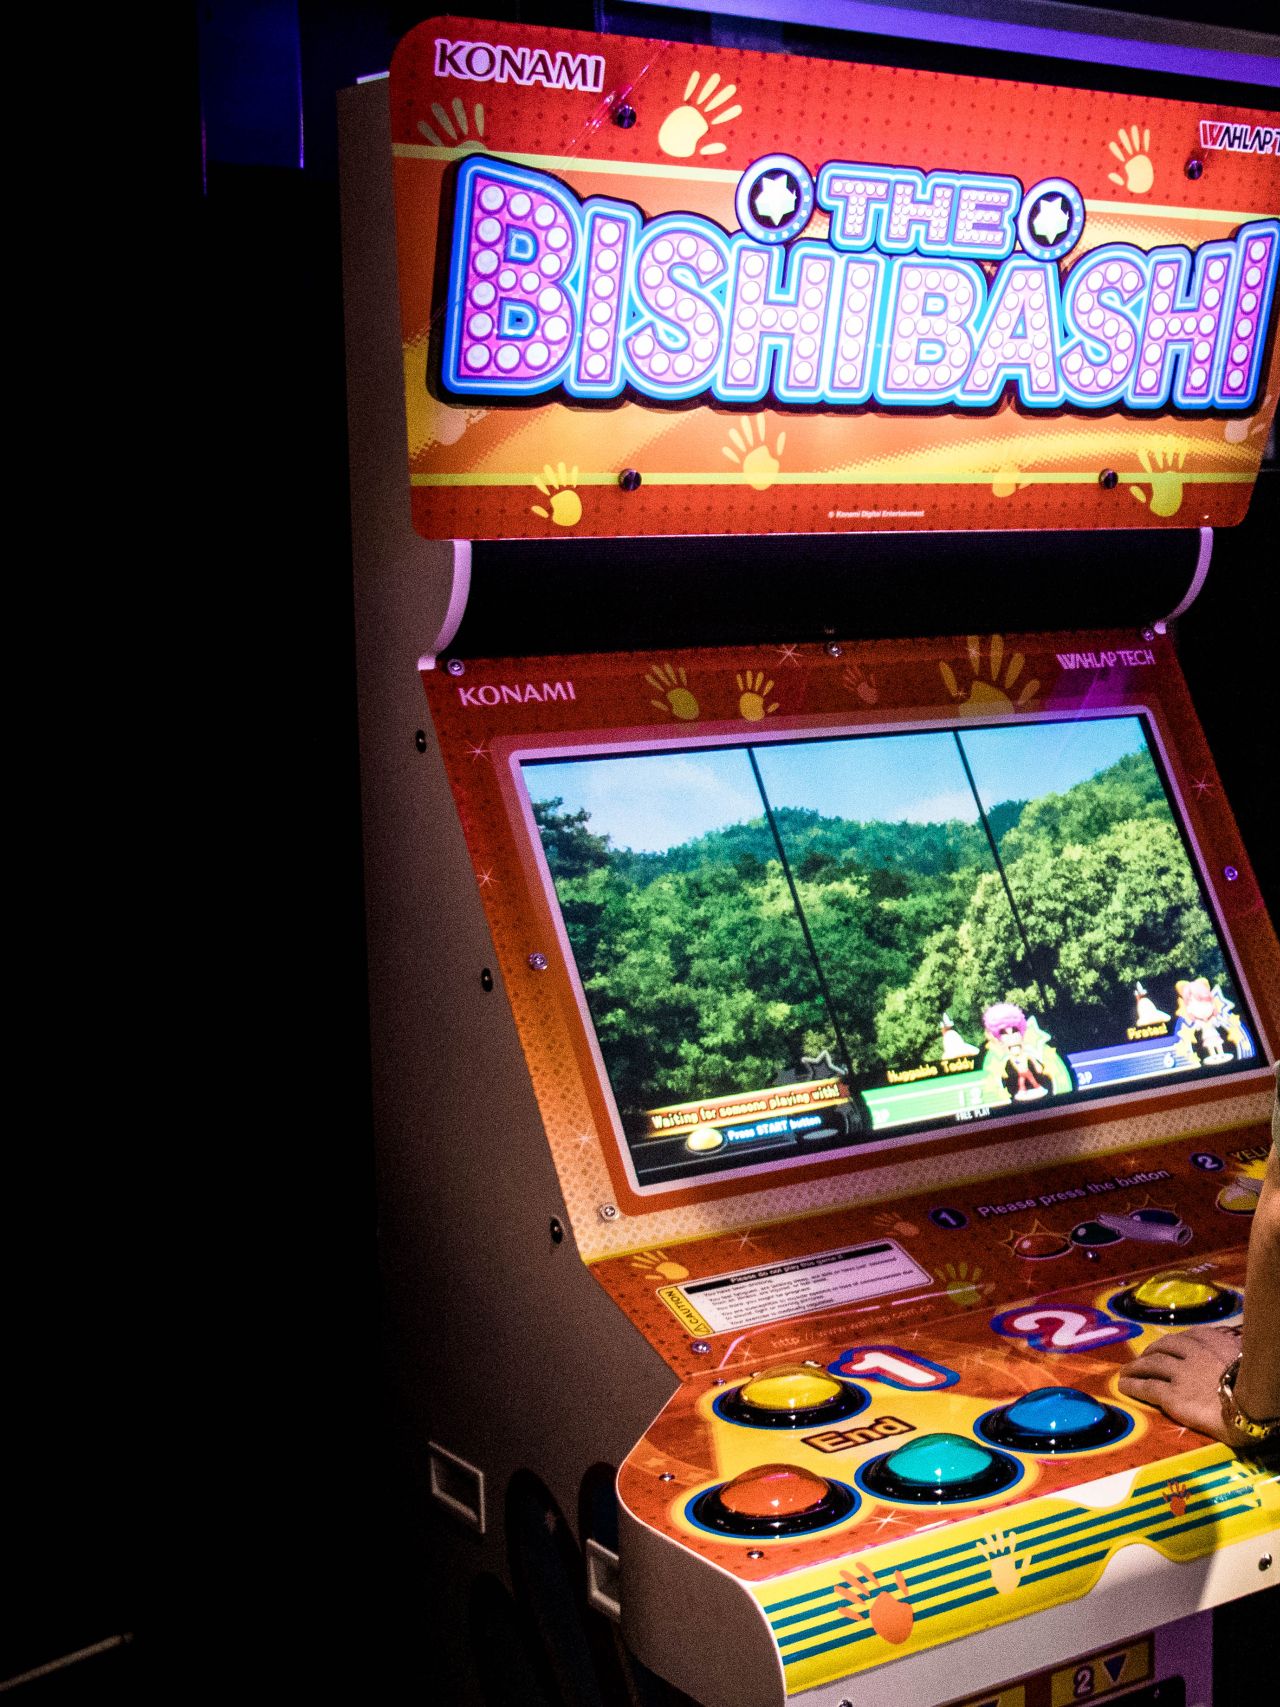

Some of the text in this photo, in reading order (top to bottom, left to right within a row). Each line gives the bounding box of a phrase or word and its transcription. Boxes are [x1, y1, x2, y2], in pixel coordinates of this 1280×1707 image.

[435, 39, 605, 92] KONAMI
[1200, 121, 1274, 153] WAHLAP
[822, 166, 1017, 255] THE
[1116, 649, 1156, 666] TECH
[458, 681, 576, 706] KONAMI
[940, 1057, 975, 1073] Teddy
[651, 1084, 840, 1129] Waiting for someone playing with!
[727, 1116, 822, 1141] Press START button
[1198, 1155, 1218, 1169] 2
[977, 1168, 1170, 1217] Please press the button
[665, 1290, 699, 1324] CAUTION
[1002, 1307, 1133, 1350] 2
[840, 1348, 949, 1387] 1
[800, 1416, 917, 1453] End
[1074, 1665, 1093, 1697] 2
